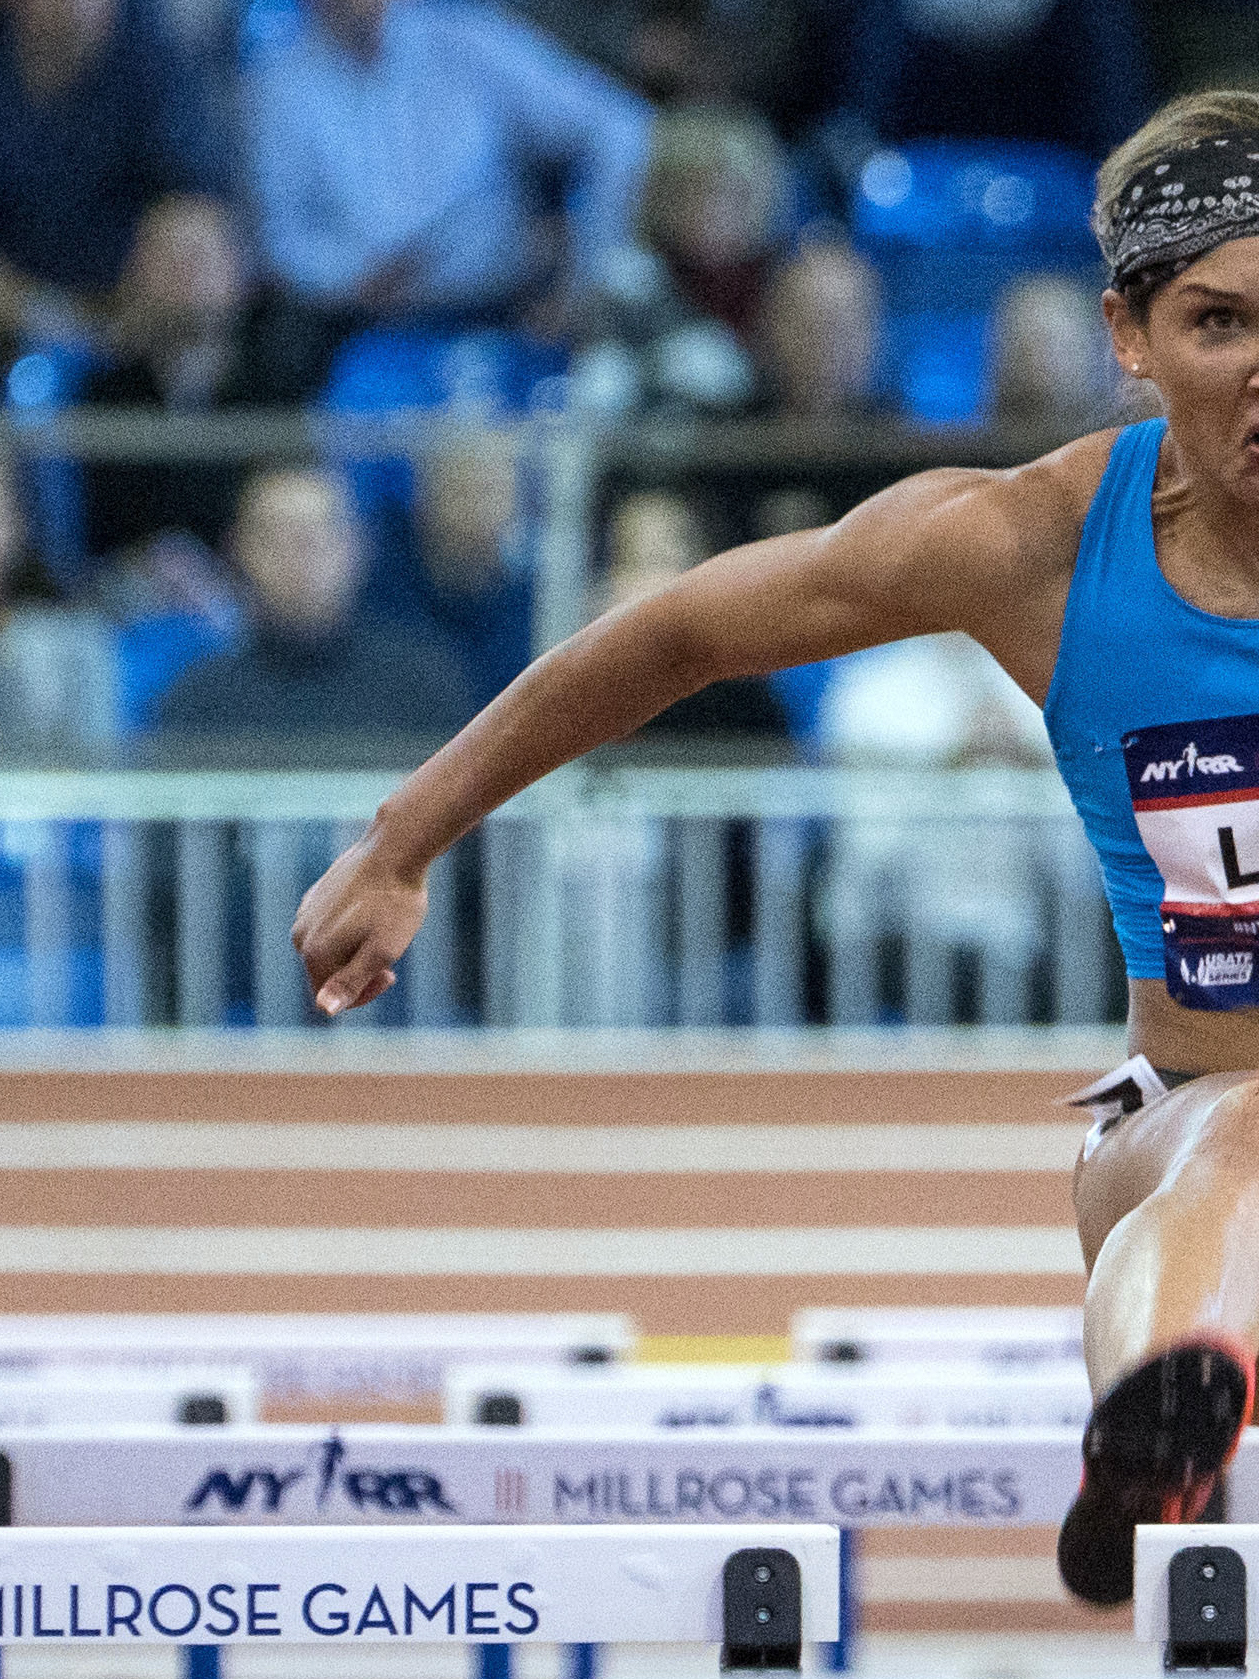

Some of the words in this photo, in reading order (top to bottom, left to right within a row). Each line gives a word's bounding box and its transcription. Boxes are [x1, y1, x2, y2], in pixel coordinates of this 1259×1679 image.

[554, 1467, 815, 1516] MILLROSE
[829, 1467, 1019, 1516] GAMES
[0, 1583, 282, 1637] ILLROSE
[302, 1582, 540, 1636] GAMES
